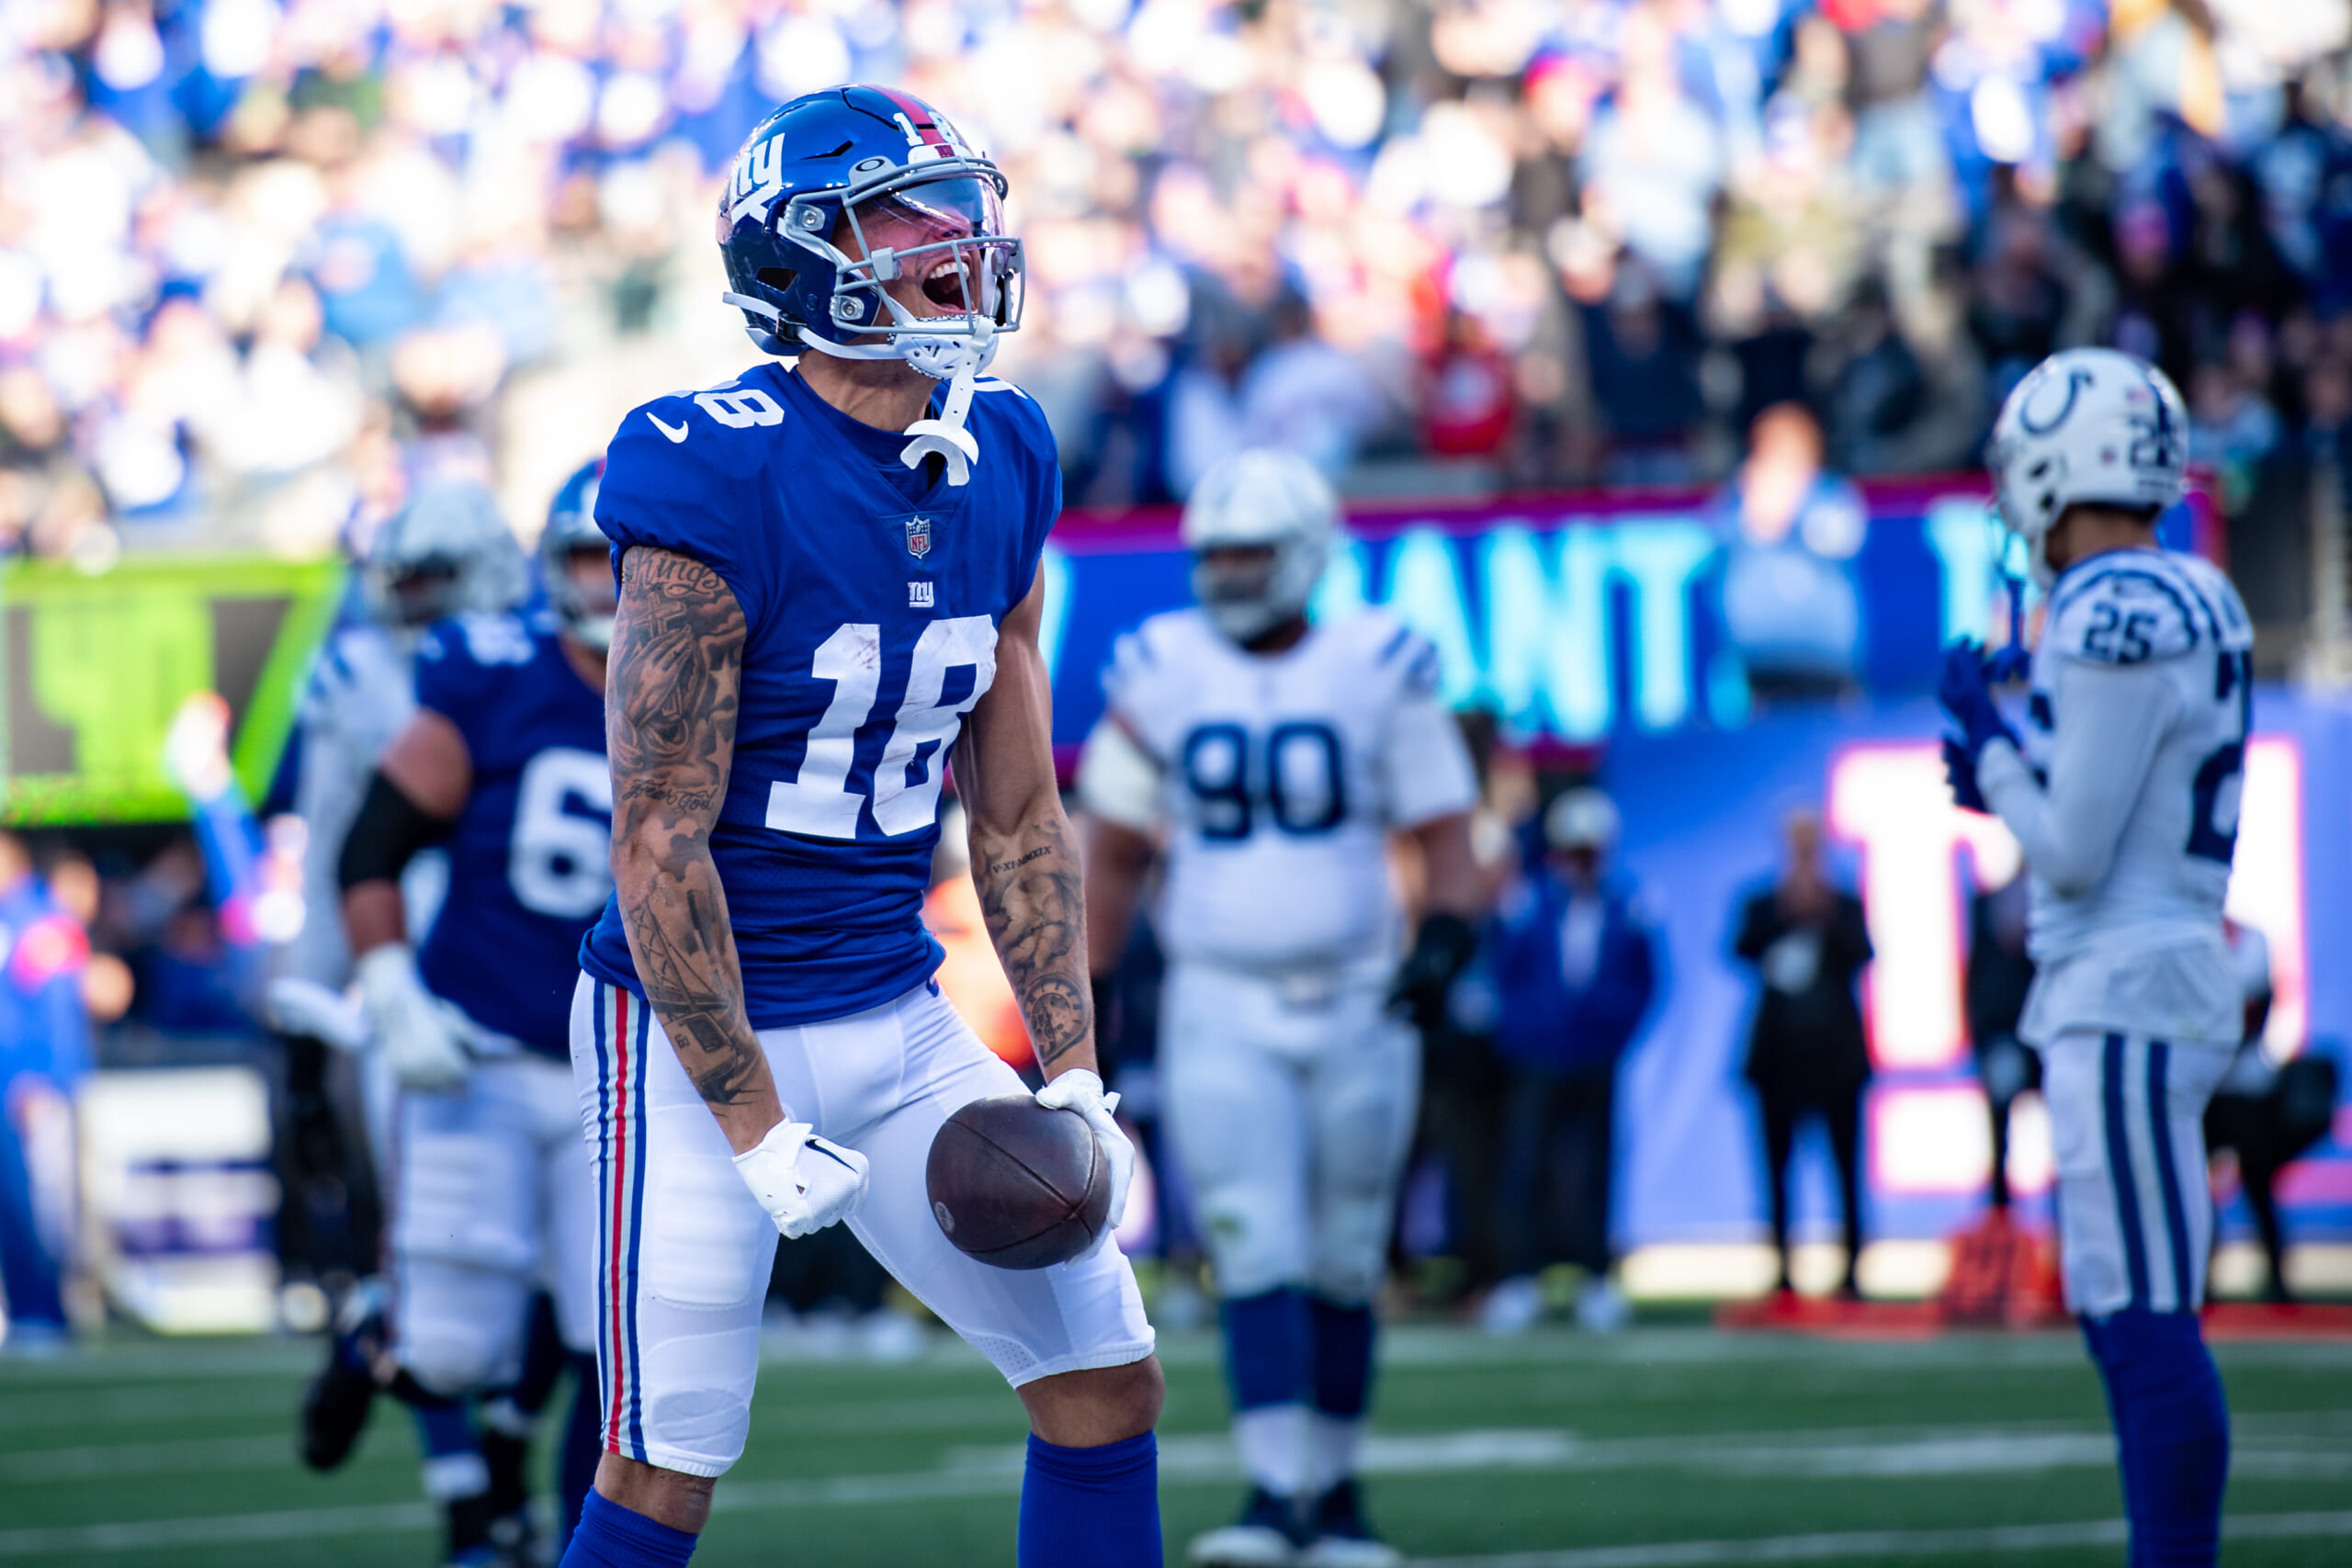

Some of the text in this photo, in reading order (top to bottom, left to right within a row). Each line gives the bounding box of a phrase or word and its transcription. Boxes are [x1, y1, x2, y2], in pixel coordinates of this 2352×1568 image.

[892, 110, 959, 147] 18
[910, 535, 929, 552] NFL
[2083, 600, 2157, 664] 25
[765, 614, 999, 840] 18
[1184, 721, 1345, 840] 90
